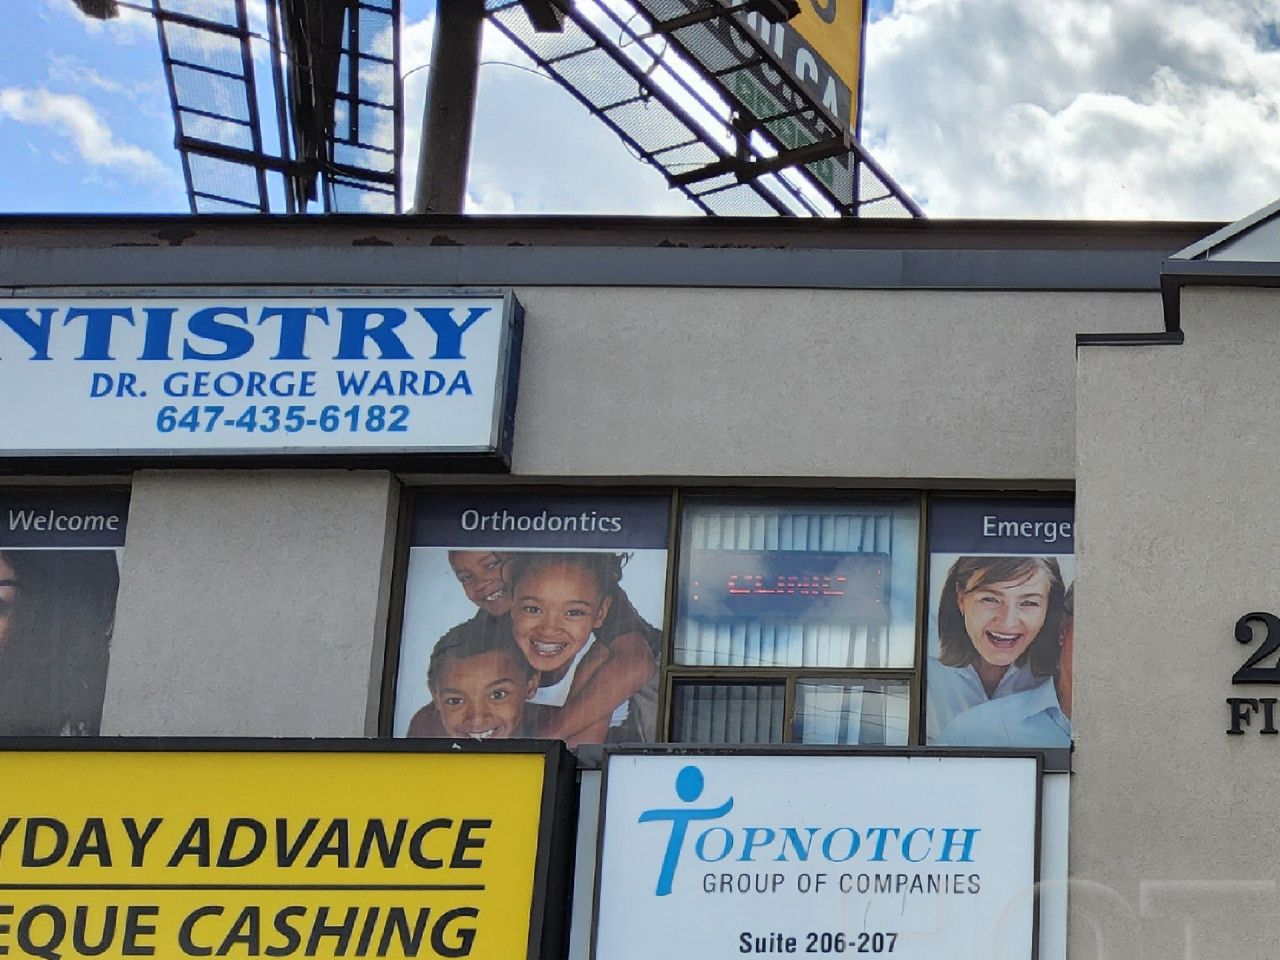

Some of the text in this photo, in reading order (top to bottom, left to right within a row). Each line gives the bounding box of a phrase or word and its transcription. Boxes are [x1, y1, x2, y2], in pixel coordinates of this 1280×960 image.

[90, 370, 473, 398] DR. GEORGE WARDA
[156, 405, 411, 433] 647-435-6182
[8, 509, 119, 533] Welcome
[461, 508, 623, 534] Orthodontics
[983, 515, 1072, 543] Emerge
[168, 817, 493, 870] ADVANCE
[703, 873, 981, 895] GROUP OF COMPANIES
[178, 905, 480, 958] CASHING
[739, 932, 898, 954] Suite 206-207
